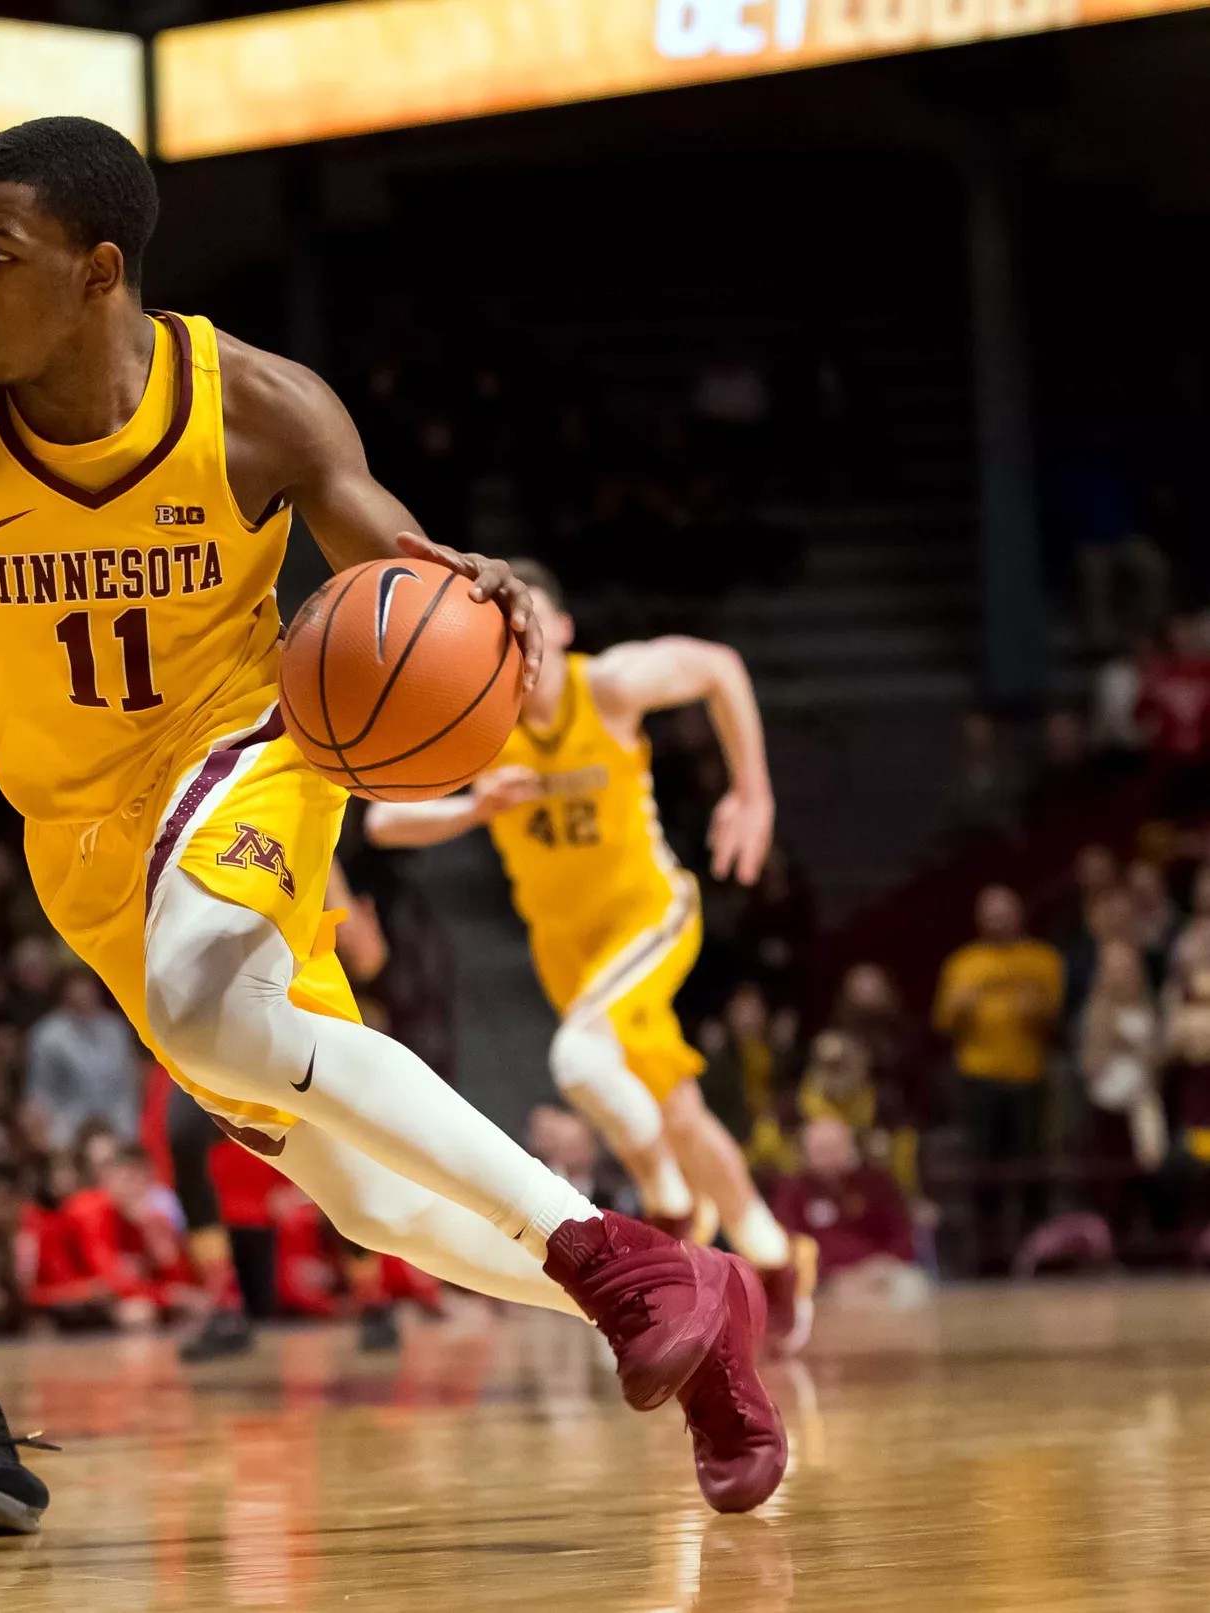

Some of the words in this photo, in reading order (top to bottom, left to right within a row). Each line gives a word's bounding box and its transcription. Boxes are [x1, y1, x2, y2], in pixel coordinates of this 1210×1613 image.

[54, 606, 165, 713] 11
[216, 822, 296, 900] M
[528, 800, 600, 849] 42
